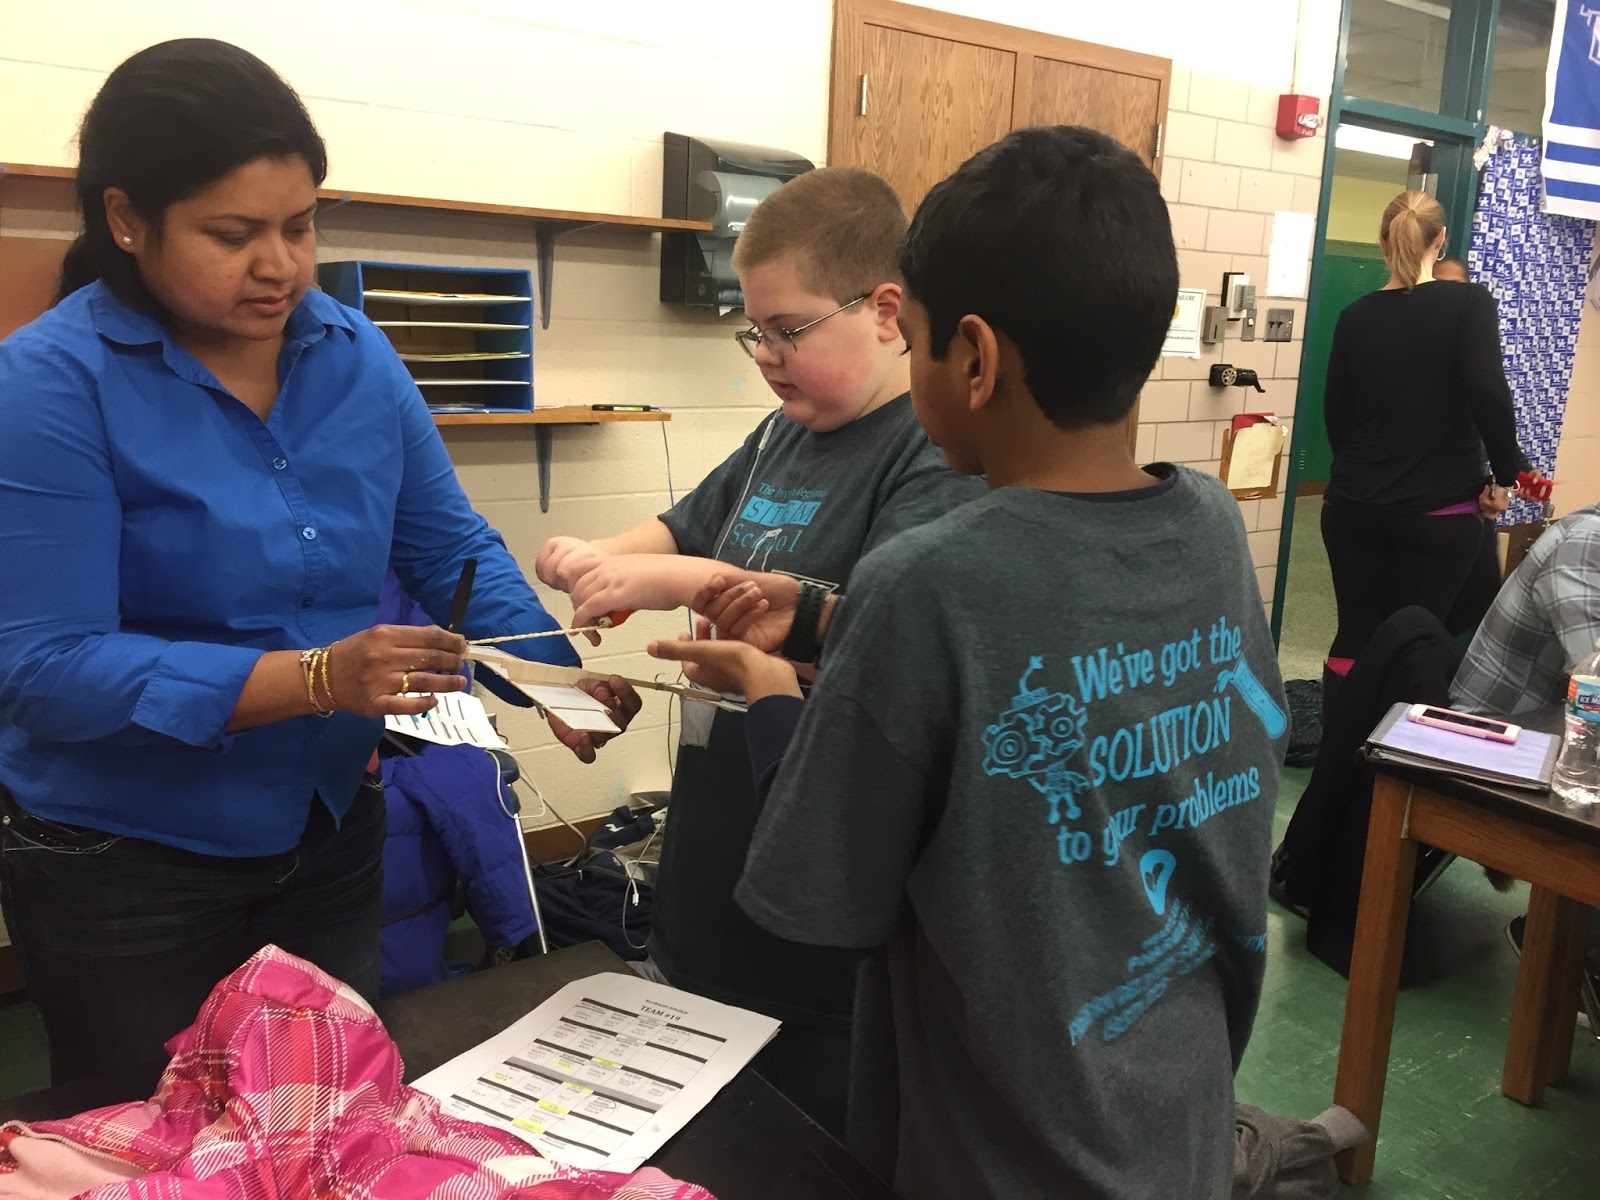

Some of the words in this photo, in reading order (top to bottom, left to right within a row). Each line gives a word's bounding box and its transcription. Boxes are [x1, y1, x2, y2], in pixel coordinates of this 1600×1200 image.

[758, 482, 775, 496] The
[746, 500, 819, 525] STEM
[1071, 643, 1155, 704] We've
[1160, 629, 1203, 687] got
[1209, 616, 1242, 665] the
[1580, 696, 1591, 704] ICE
[1089, 696, 1232, 788] SOLUTION
[1056, 823, 1092, 865] to
[1148, 766, 1261, 837] problems
[640, 1005, 664, 1017] TEAM
[664, 1013, 681, 1021] #19
